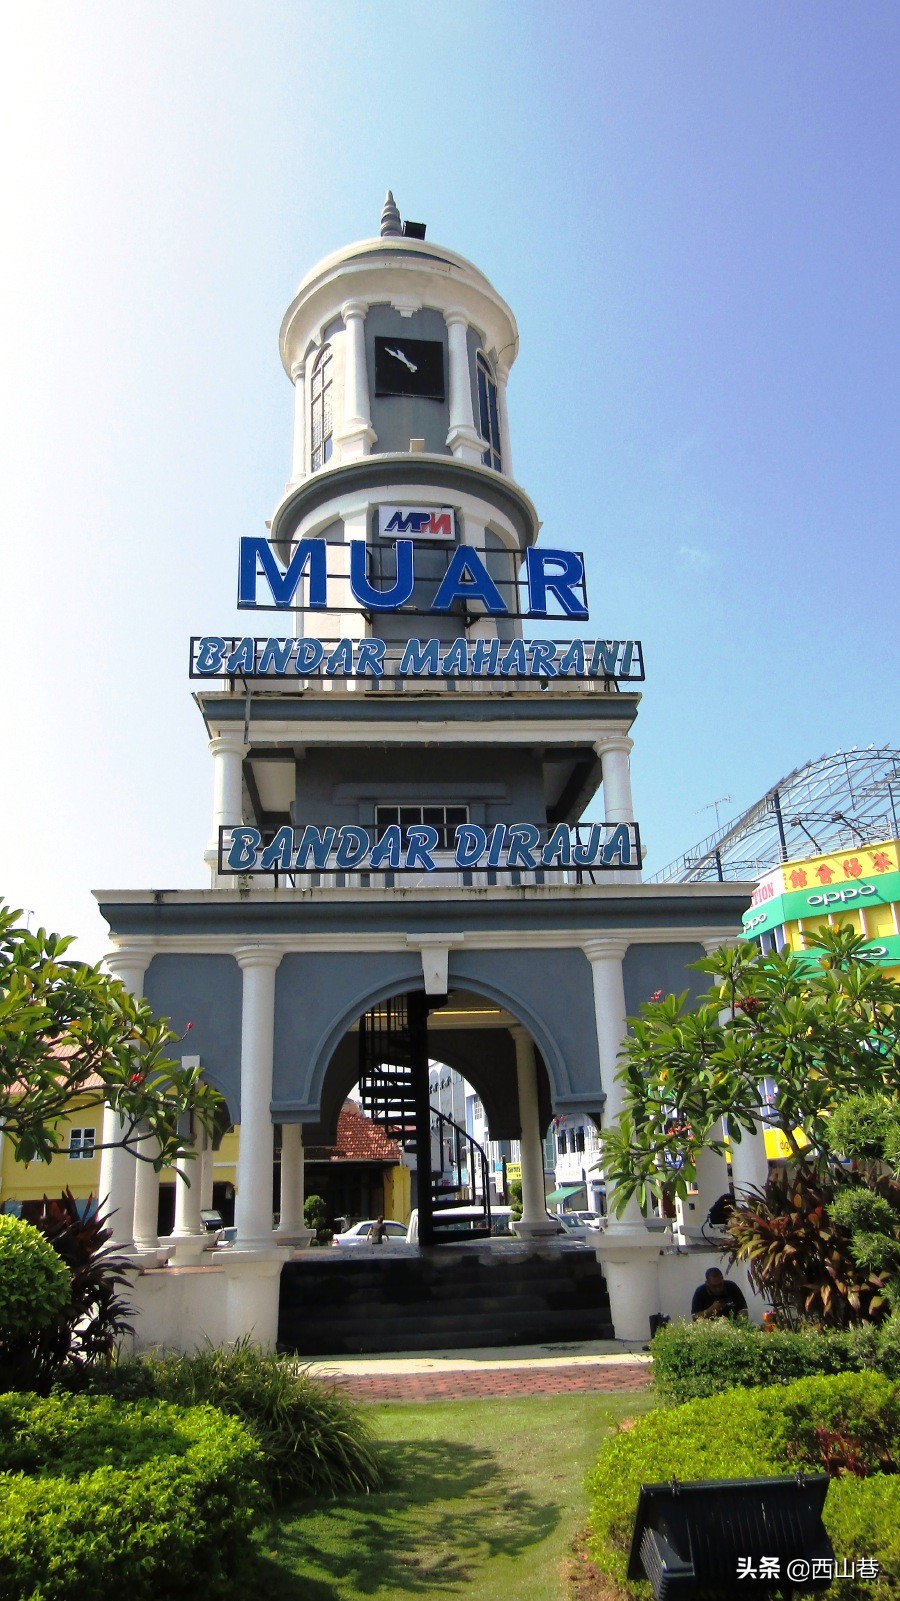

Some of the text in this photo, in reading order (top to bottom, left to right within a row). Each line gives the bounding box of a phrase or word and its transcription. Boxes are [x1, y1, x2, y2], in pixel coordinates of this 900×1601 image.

[384, 511, 452, 535] MPM
[238, 537, 588, 618] MUAR
[196, 637, 637, 677] BANDAR MAHARANI
[227, 823, 632, 871] BANDAR DIRAJA
[751, 882, 774, 907] TION
[744, 913, 767, 934] ppo
